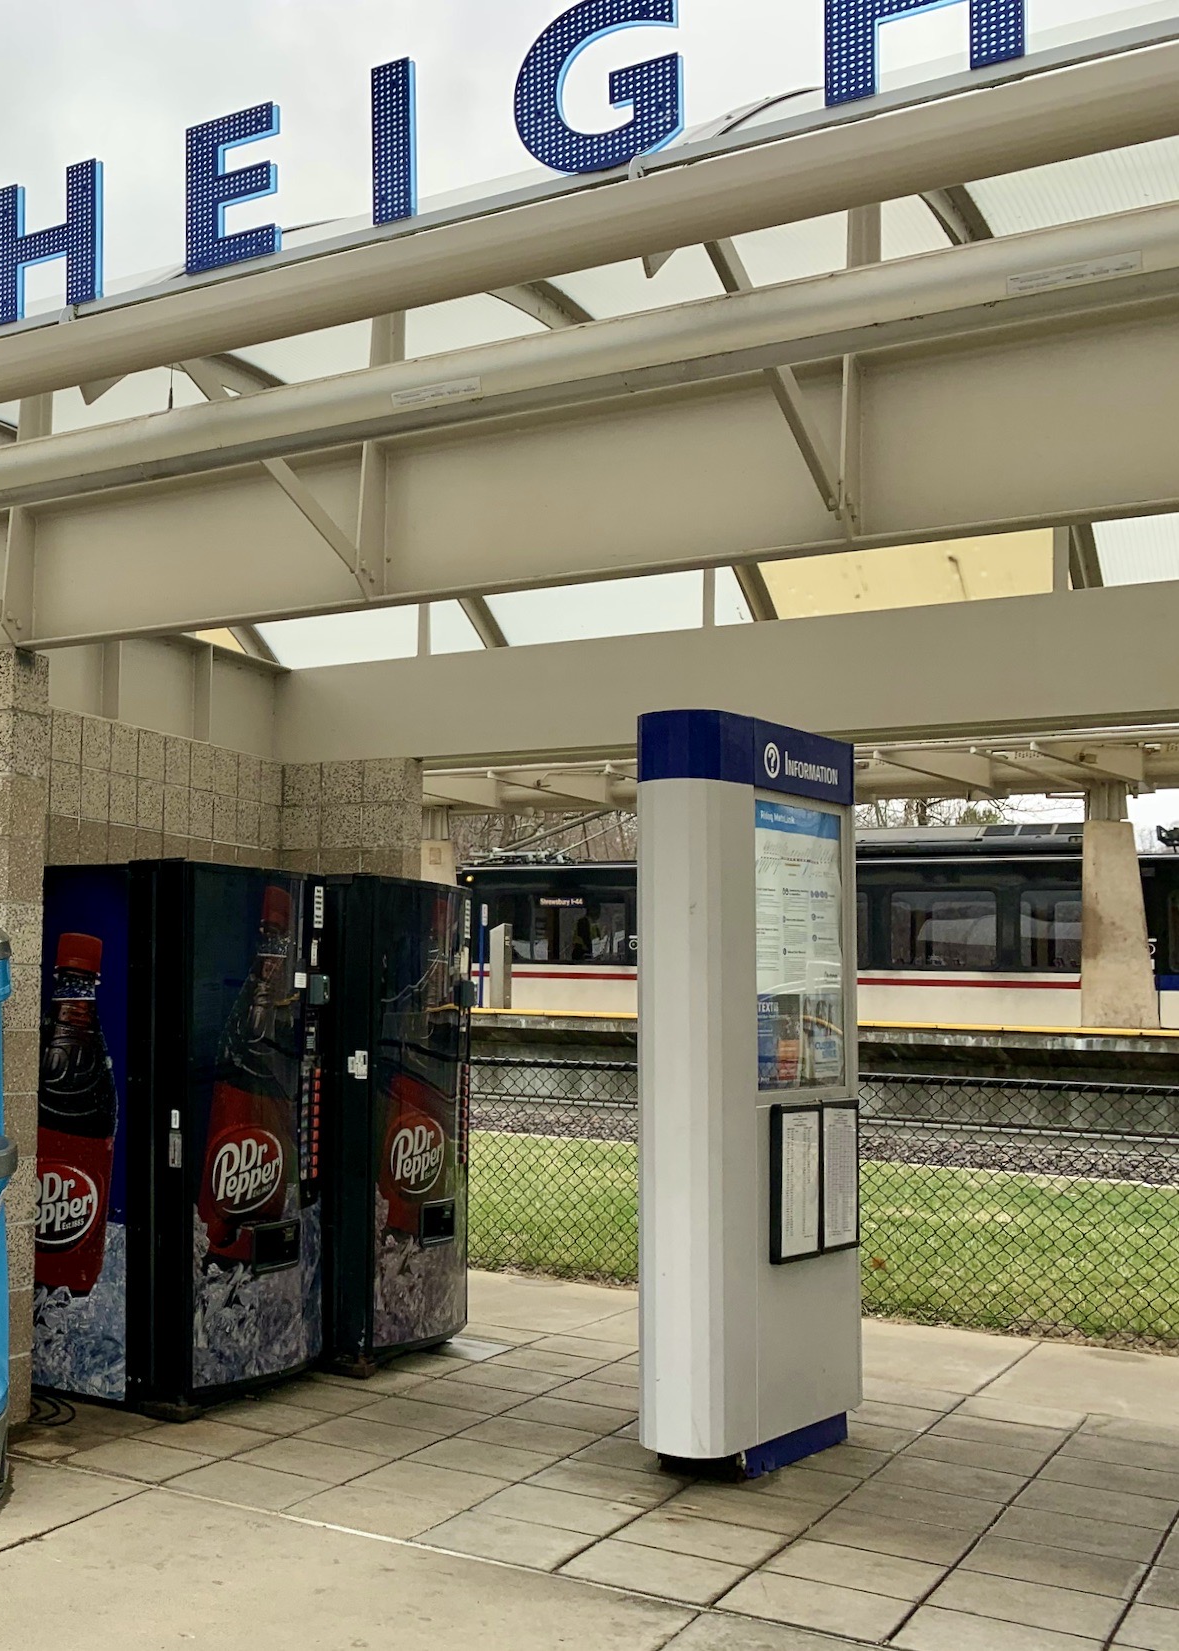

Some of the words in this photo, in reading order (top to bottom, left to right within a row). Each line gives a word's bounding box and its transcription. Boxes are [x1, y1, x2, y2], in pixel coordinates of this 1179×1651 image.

[785, 751, 838, 785] INFORMATION
[239, 1138, 268, 1172] Dr
[392, 1128, 442, 1185] Pepper
[413, 1126, 434, 1155] Dr
[42, 1172, 76, 1203] Dr
[214, 1142, 280, 1205] Pepper
